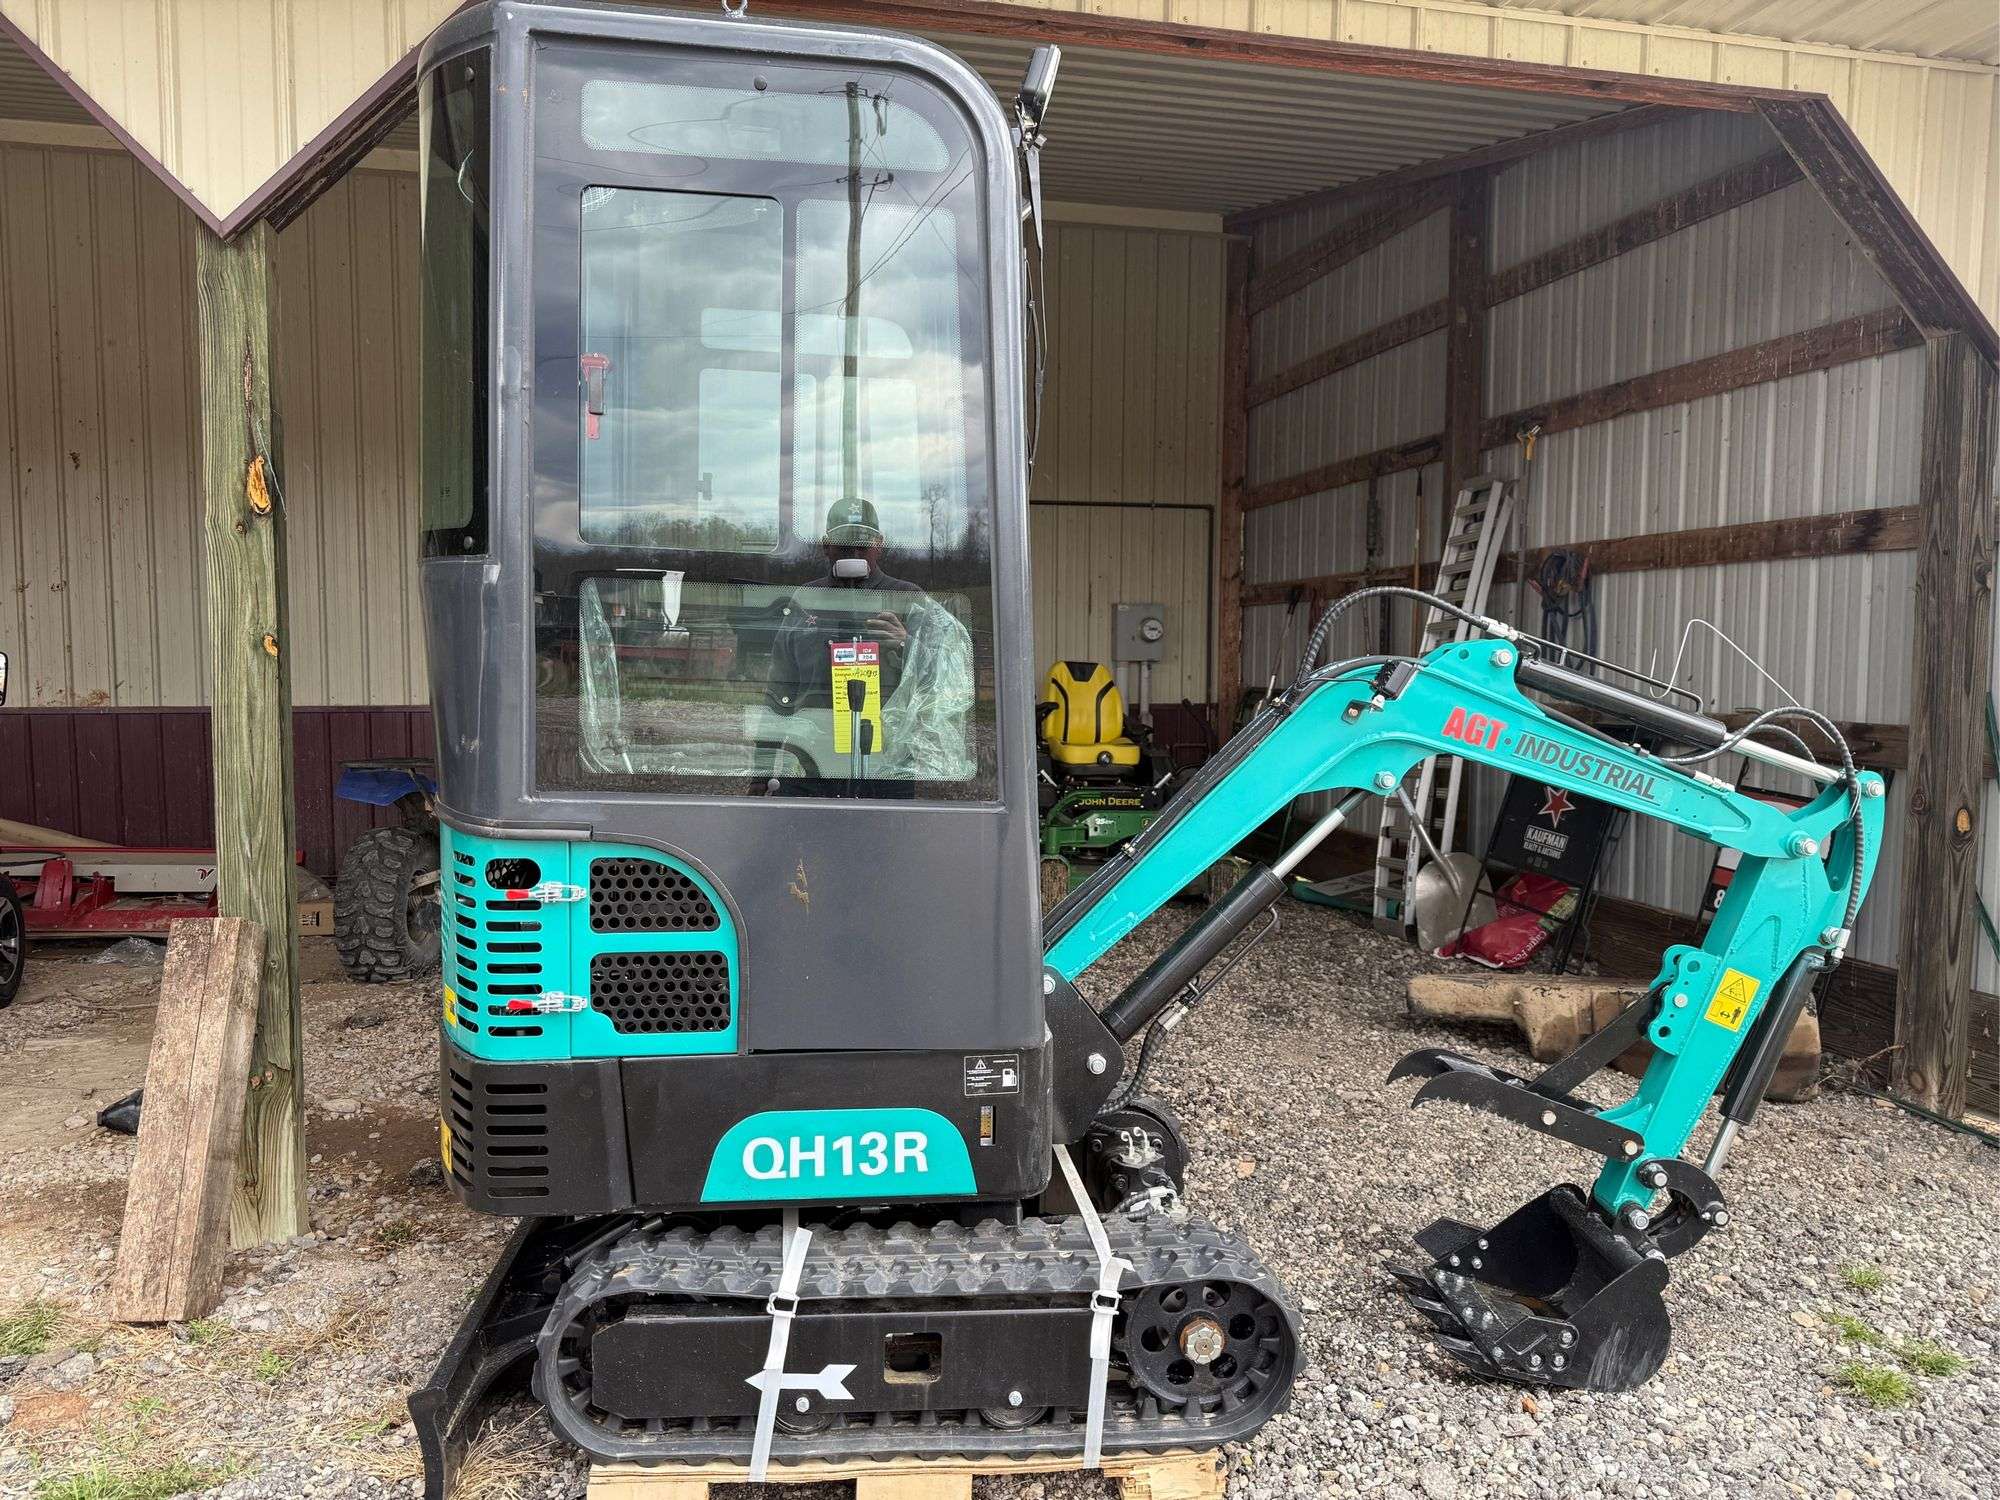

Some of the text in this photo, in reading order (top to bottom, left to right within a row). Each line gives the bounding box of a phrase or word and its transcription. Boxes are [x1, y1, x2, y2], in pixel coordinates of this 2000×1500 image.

[1442, 706, 1656, 800] AGT INDUSTRIAL
[1078, 797, 1141, 806] JOHN DEERE
[1526, 827, 1566, 849] KAUFMAN
[1714, 889, 1726, 908] 8
[742, 1131, 929, 1180] QH13R
